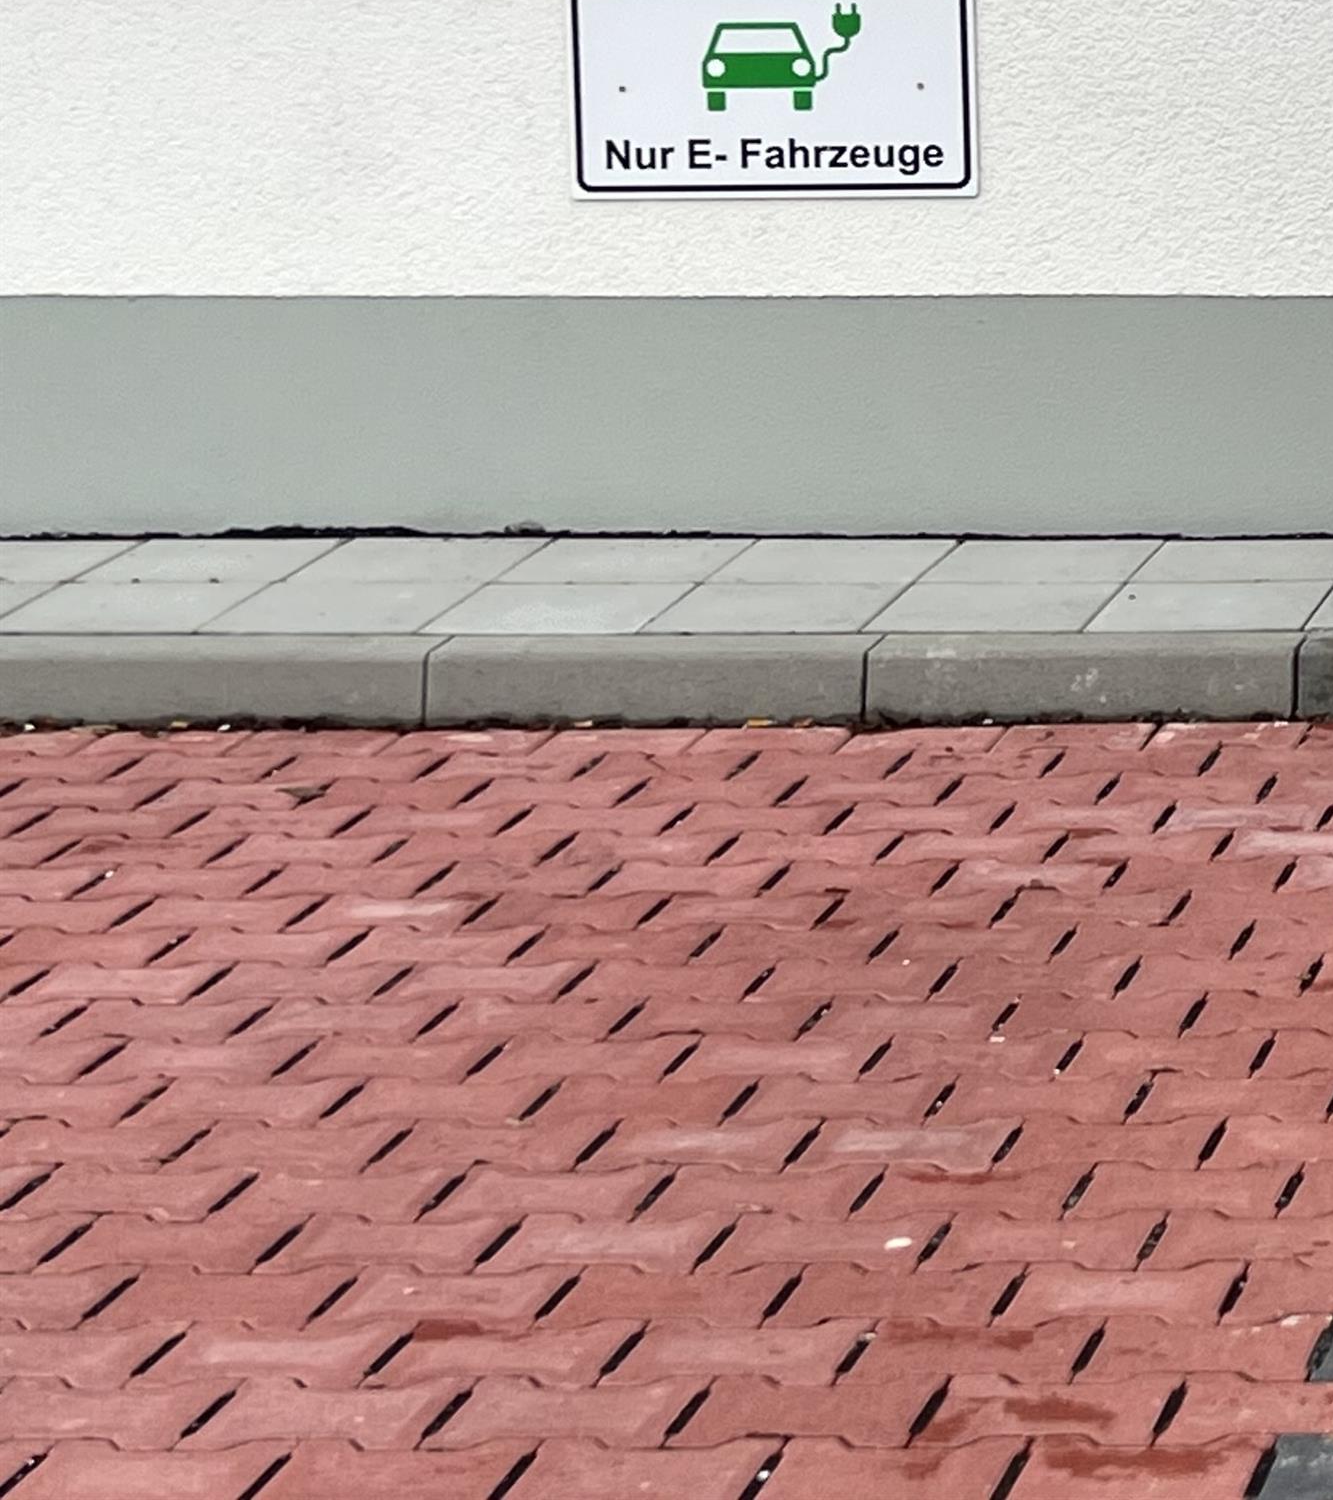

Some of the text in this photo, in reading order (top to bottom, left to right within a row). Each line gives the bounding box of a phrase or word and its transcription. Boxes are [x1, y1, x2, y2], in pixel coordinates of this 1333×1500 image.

[605, 138, 945, 175] Nur E- Fahrzeuge
